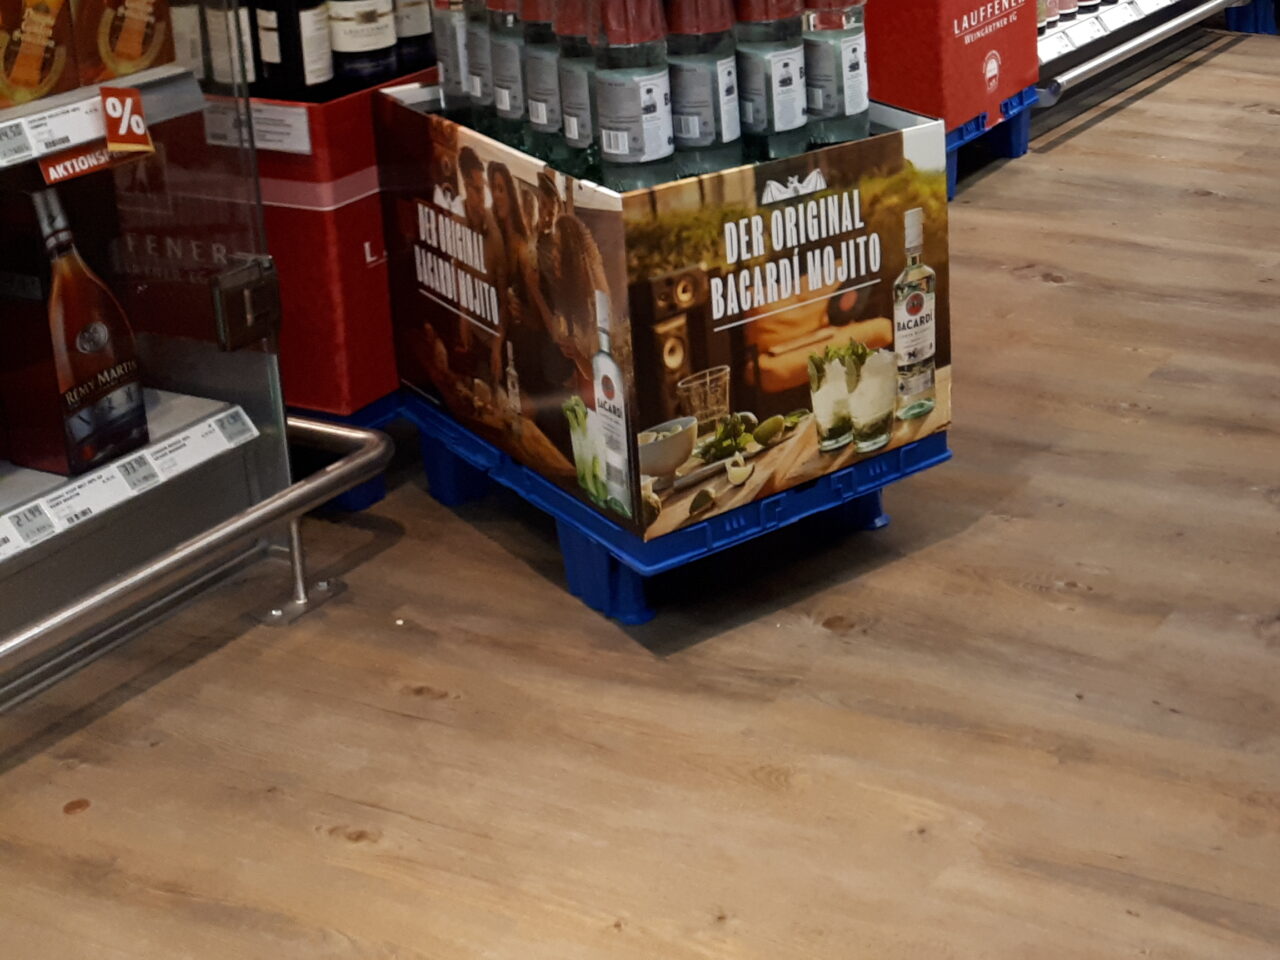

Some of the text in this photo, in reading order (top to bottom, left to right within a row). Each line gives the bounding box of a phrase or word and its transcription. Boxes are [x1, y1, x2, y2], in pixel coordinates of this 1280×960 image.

[724, 189, 865, 264] DER ORIGINAL
[458, 268, 499, 326] MOJITO
[711, 232, 881, 321] BACARDÍ MOJITO
